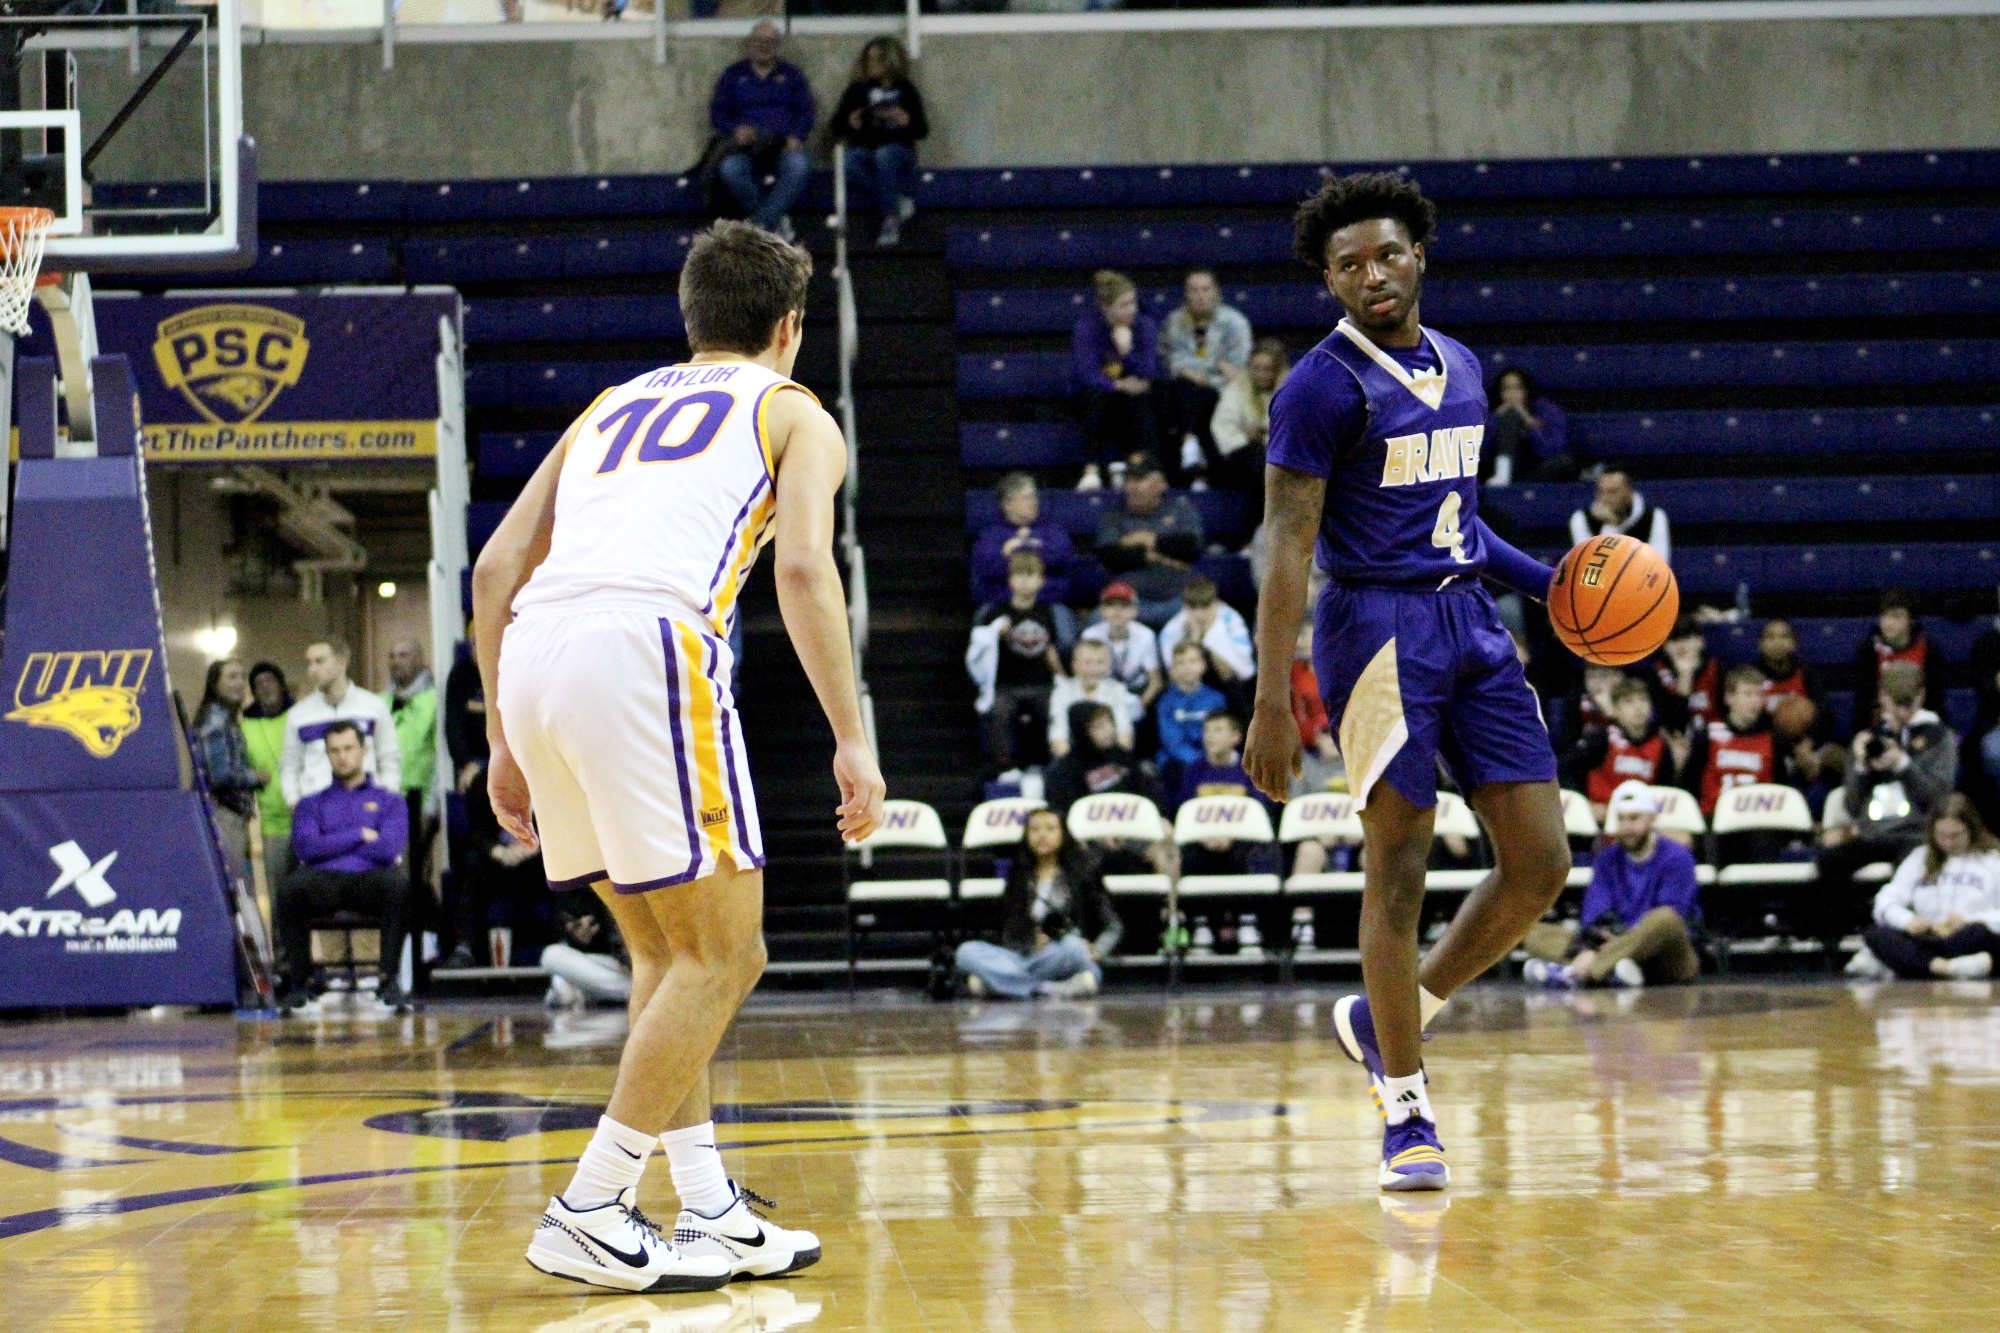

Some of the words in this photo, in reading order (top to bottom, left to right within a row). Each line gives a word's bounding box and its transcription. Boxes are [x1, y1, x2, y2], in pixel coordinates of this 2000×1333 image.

[172, 327, 293, 377] PSC
[645, 367, 740, 388] TAYLOR
[593, 390, 738, 477] 10
[1432, 491, 1474, 564] 4
[1581, 536, 1621, 586] ELITE
[15, 649, 152, 707] UNI
[1087, 802, 1138, 822] UNI
[1301, 801, 1350, 821] UNI
[1733, 792, 1786, 812] UNI
[700, 805, 728, 824] VALLEY
[882, 809, 920, 829] NI
[986, 808, 1027, 827] UN
[1195, 802, 1248, 823] UNI
[105, 935, 177, 951] Mediacom
